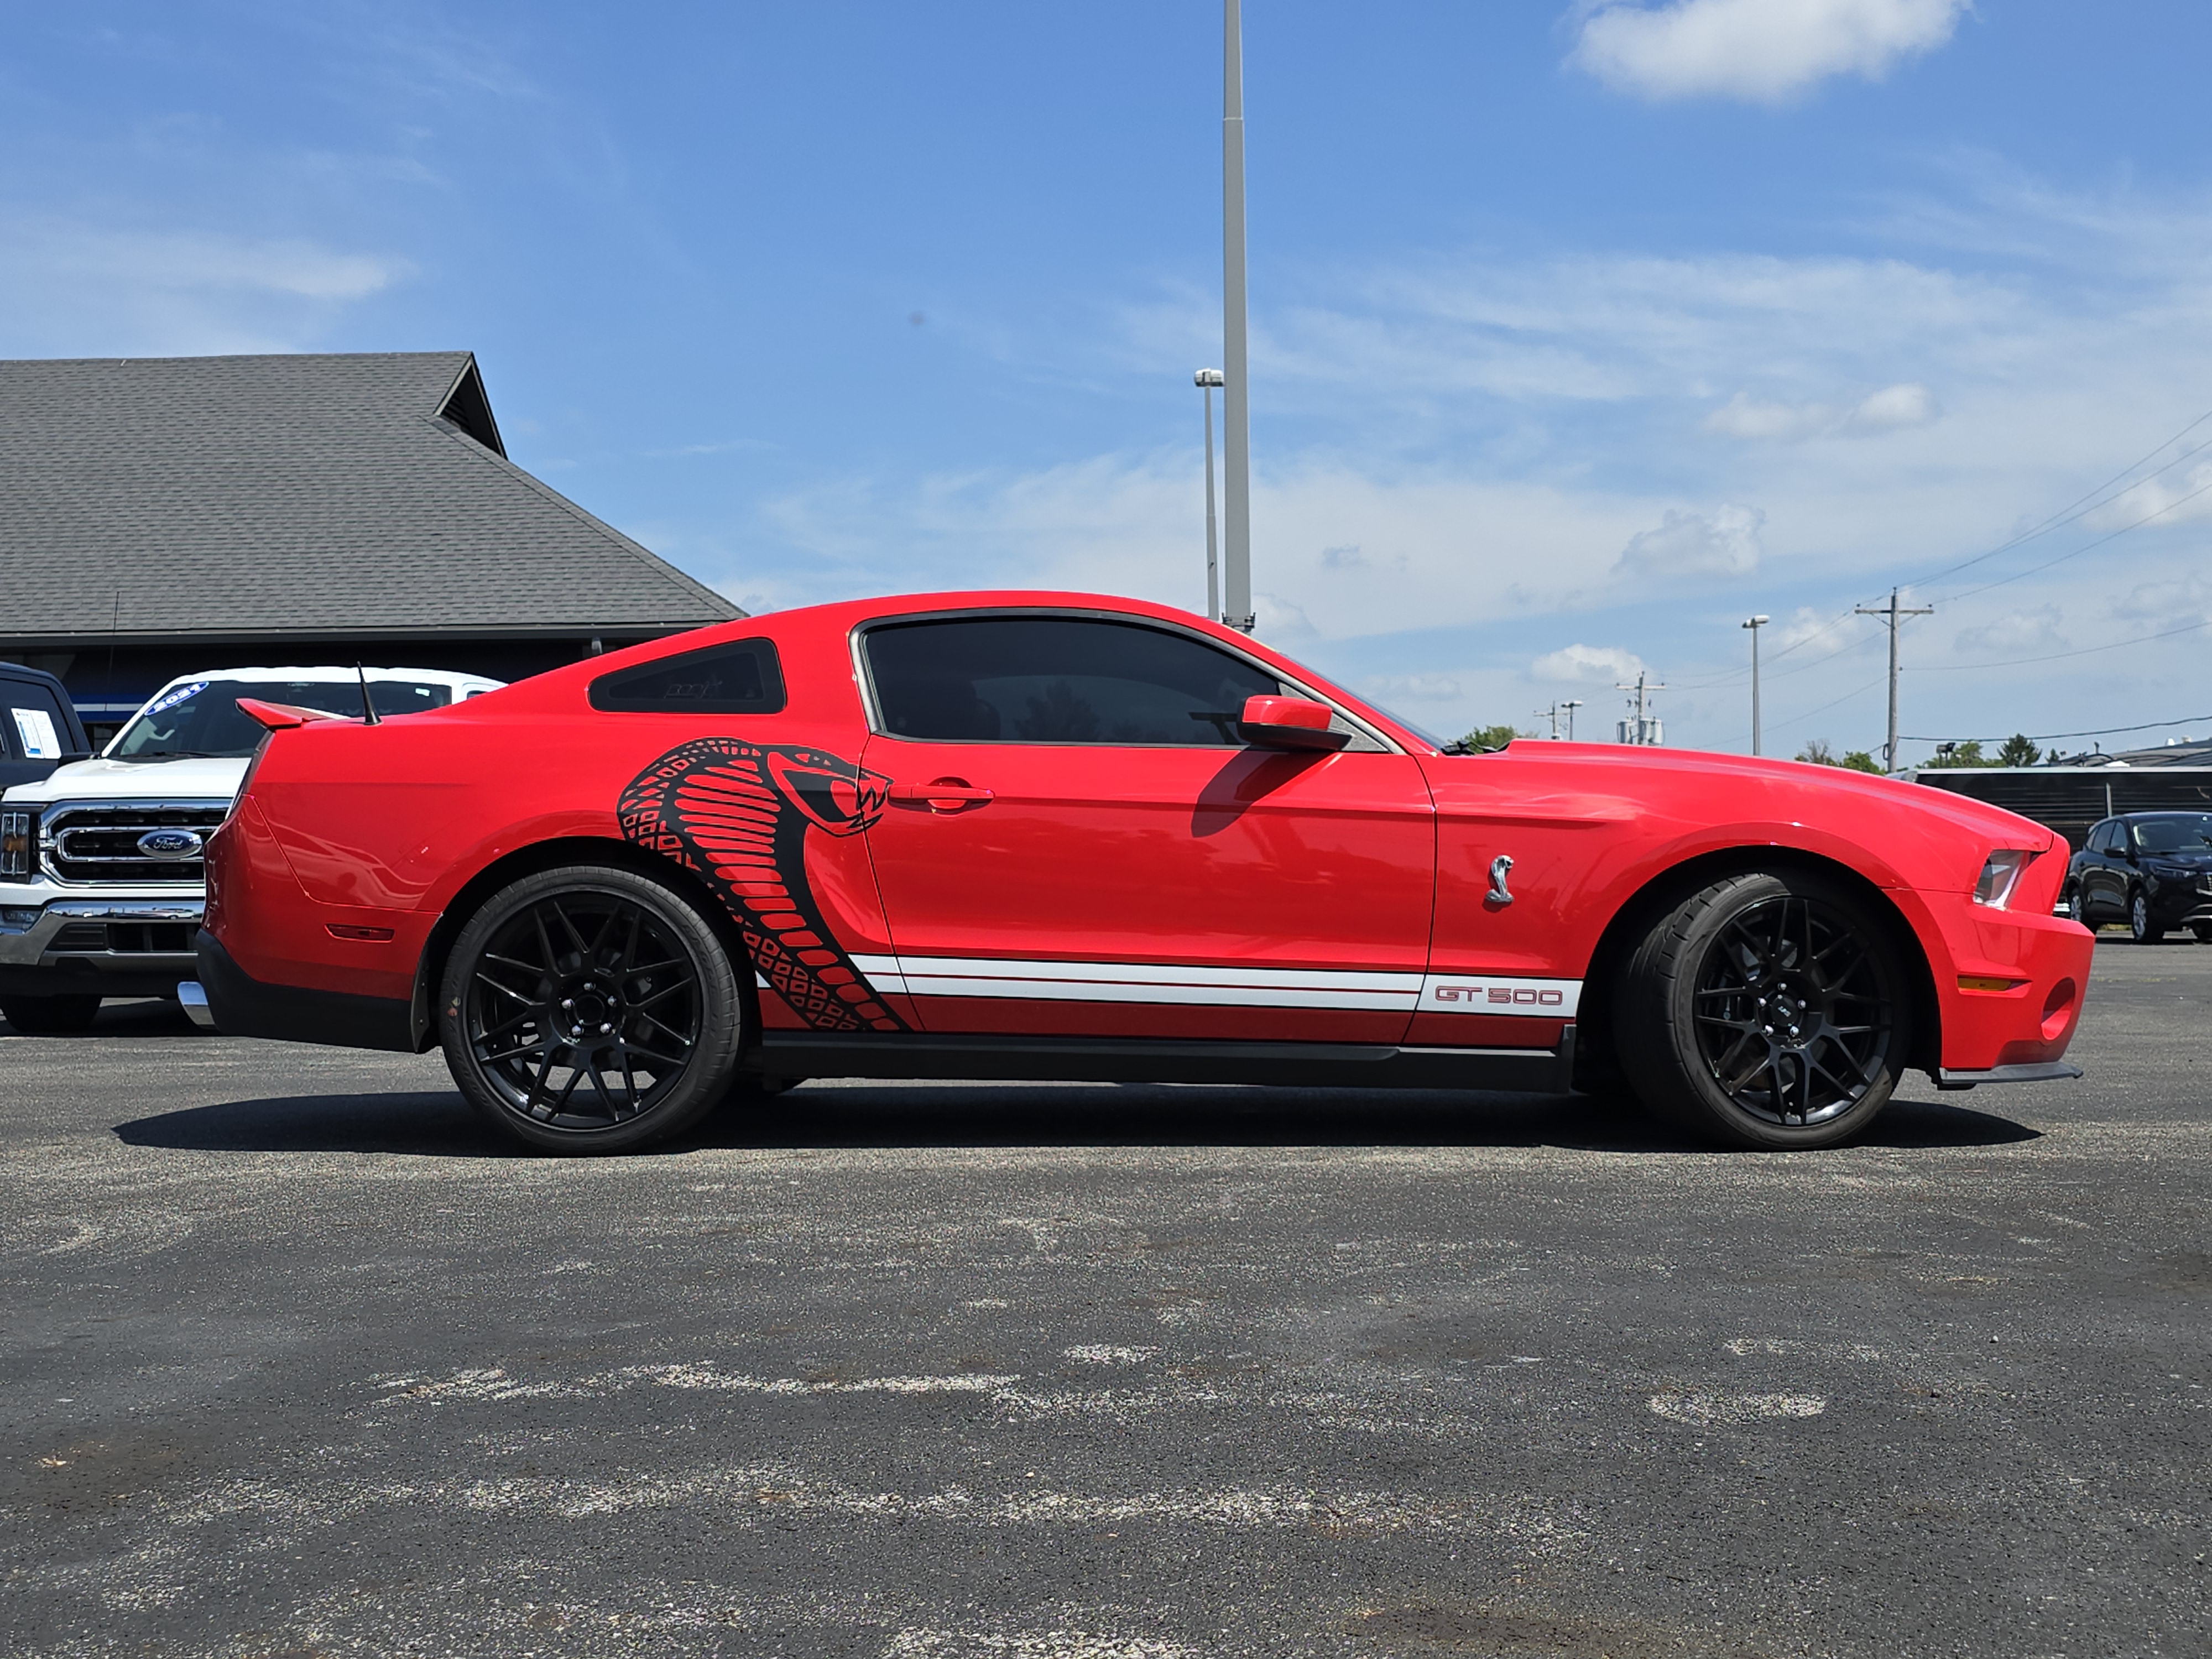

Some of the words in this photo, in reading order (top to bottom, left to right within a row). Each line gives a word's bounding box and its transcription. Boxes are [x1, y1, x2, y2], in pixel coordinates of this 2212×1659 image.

[154, 684, 200, 713] 2021
[153, 836, 184, 849] Ford
[1435, 985, 1483, 1001] GT
[1488, 988, 1563, 1005] 500
